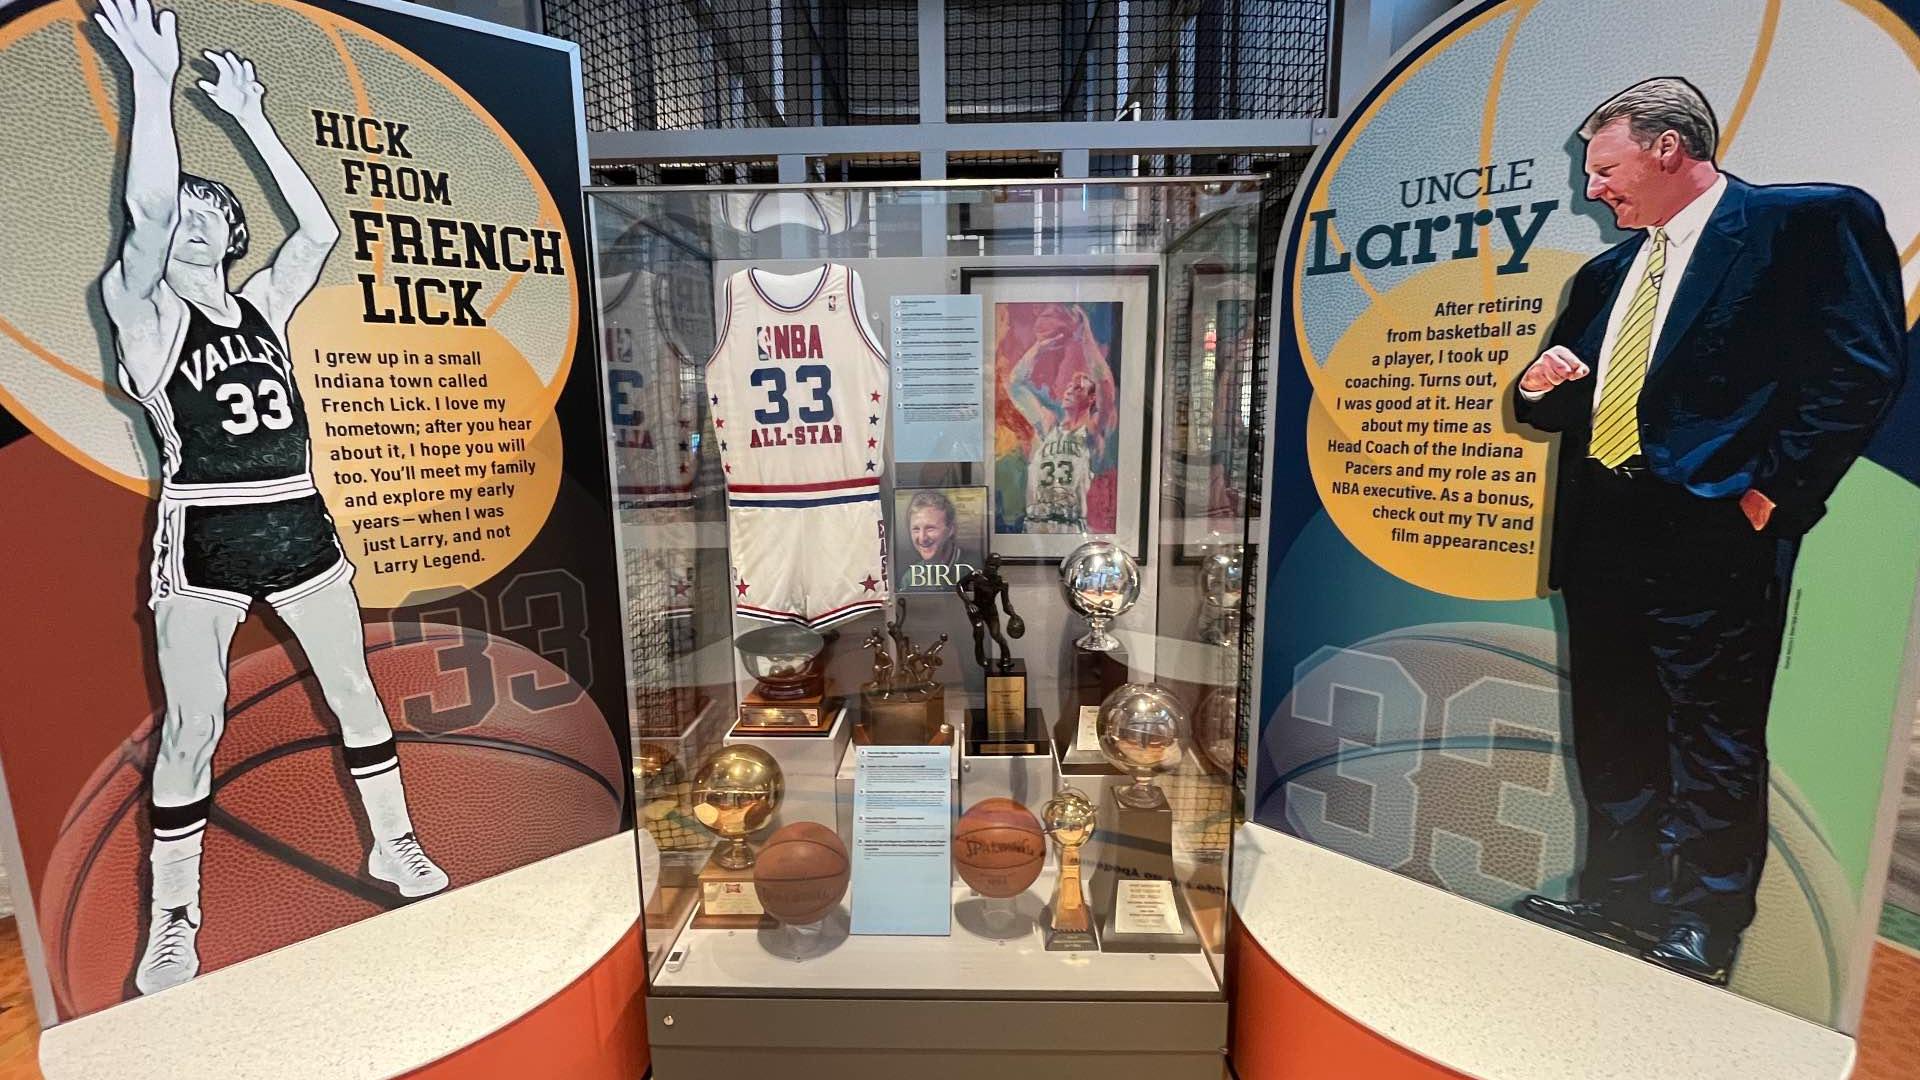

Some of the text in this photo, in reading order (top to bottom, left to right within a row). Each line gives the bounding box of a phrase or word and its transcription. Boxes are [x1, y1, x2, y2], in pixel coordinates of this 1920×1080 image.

[311, 110, 412, 158] HICK
[341, 159, 451, 205] FROM
[1399, 159, 1534, 208] UNCLE
[350, 210, 564, 275] FRENCH
[1306, 200, 1559, 276] Larry
[358, 274, 486, 326] LICK
[1434, 297, 1543, 317] After retiring
[774, 325, 823, 359] NBA
[1387, 321, 1536, 343] from basketball as
[314, 349, 481, 367] I grew up in a small
[1372, 349, 1508, 368] a player, I took up
[314, 373, 487, 388] Indiana town called
[1345, 372, 1497, 390] coaching. Turns out,
[216, 379, 293, 435] 33
[322, 396, 506, 412] French Lick. I love my
[751, 365, 834, 424] 33
[1337, 396, 1493, 413] I was good at it. Hear
[326, 418, 532, 437] hometown; after you hear
[1361, 418, 1491, 436] about my time as
[330, 438, 525, 461] about it, I hope you will
[1328, 440, 1523, 458] Head Coach of the Indiana
[334, 471, 367, 485] too.
[420, 464, 461, 479] meet
[465, 464, 487, 478] my
[491, 460, 536, 475] family
[1040, 461, 1074, 486] 33
[1345, 462, 1536, 483] Pacers and my role as an
[345, 482, 515, 507] and explore my early
[1332, 482, 1534, 508] NBA executive. As a bonus,
[466, 507, 470, 520] I
[474, 506, 504, 518] was
[1373, 505, 1534, 531] check out my TV and
[363, 525, 511, 555] just Larry, and not
[1392, 528, 1534, 555] film appearances!
[374, 549, 485, 575] Larry Legend.
[388, 568, 593, 739] 33
